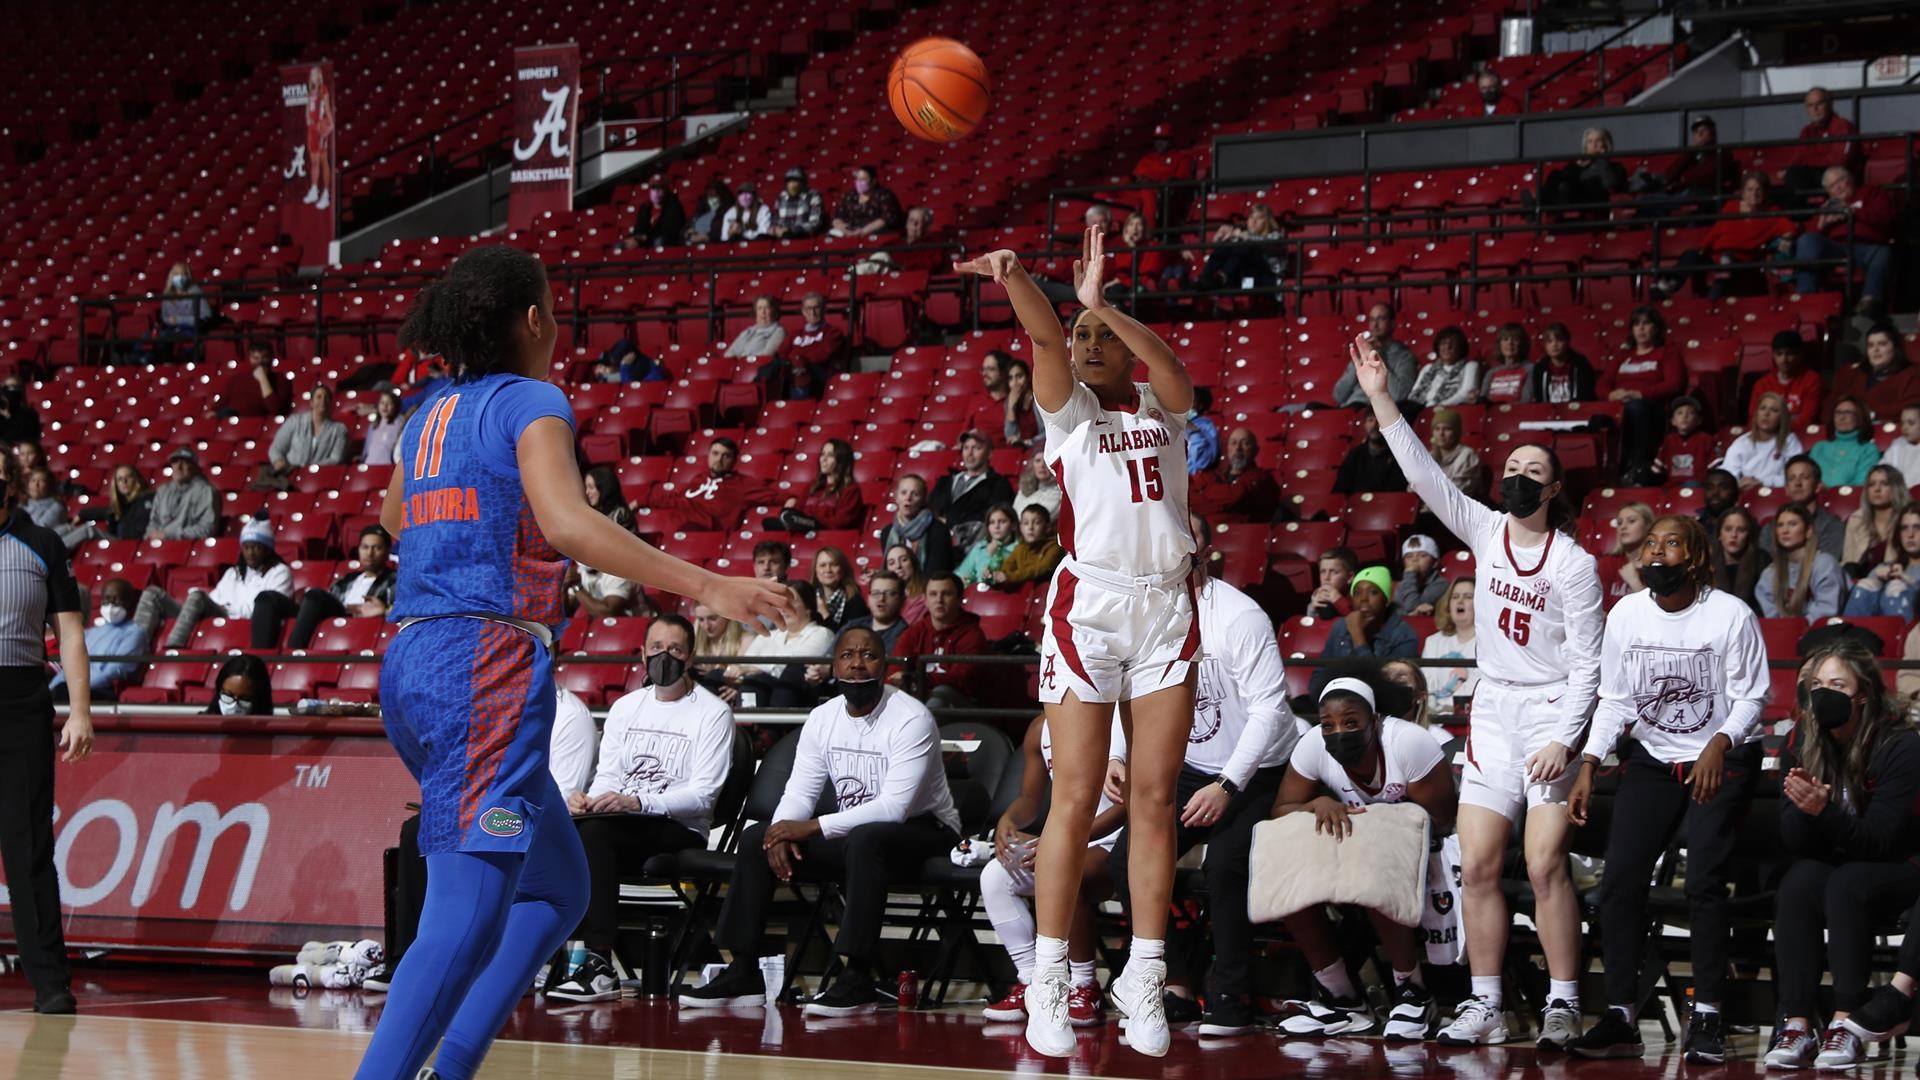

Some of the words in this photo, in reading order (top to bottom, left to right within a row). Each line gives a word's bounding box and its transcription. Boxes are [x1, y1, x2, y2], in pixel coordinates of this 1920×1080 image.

[518, 66, 559, 80] WOMEN'S
[513, 85, 571, 161] A
[283, 144, 306, 178] A
[510, 167, 573, 183] BASKETBALL
[414, 393, 461, 480] 11
[1098, 427, 1170, 454] ALABAMA
[1126, 456, 1165, 504] 15
[411, 487, 480, 526] OLIVEIRA
[1489, 577, 1546, 612] ALABAMA
[1498, 607, 1532, 647] 45
[1040, 653, 1056, 690] A
[1624, 650, 1655, 695] WE
[1663, 653, 1722, 696] BACK
[1637, 676, 1704, 714] Pat
[1667, 708, 1685, 724] A
[295, 764, 331, 789] TM
[0, 799, 270, 912] om
